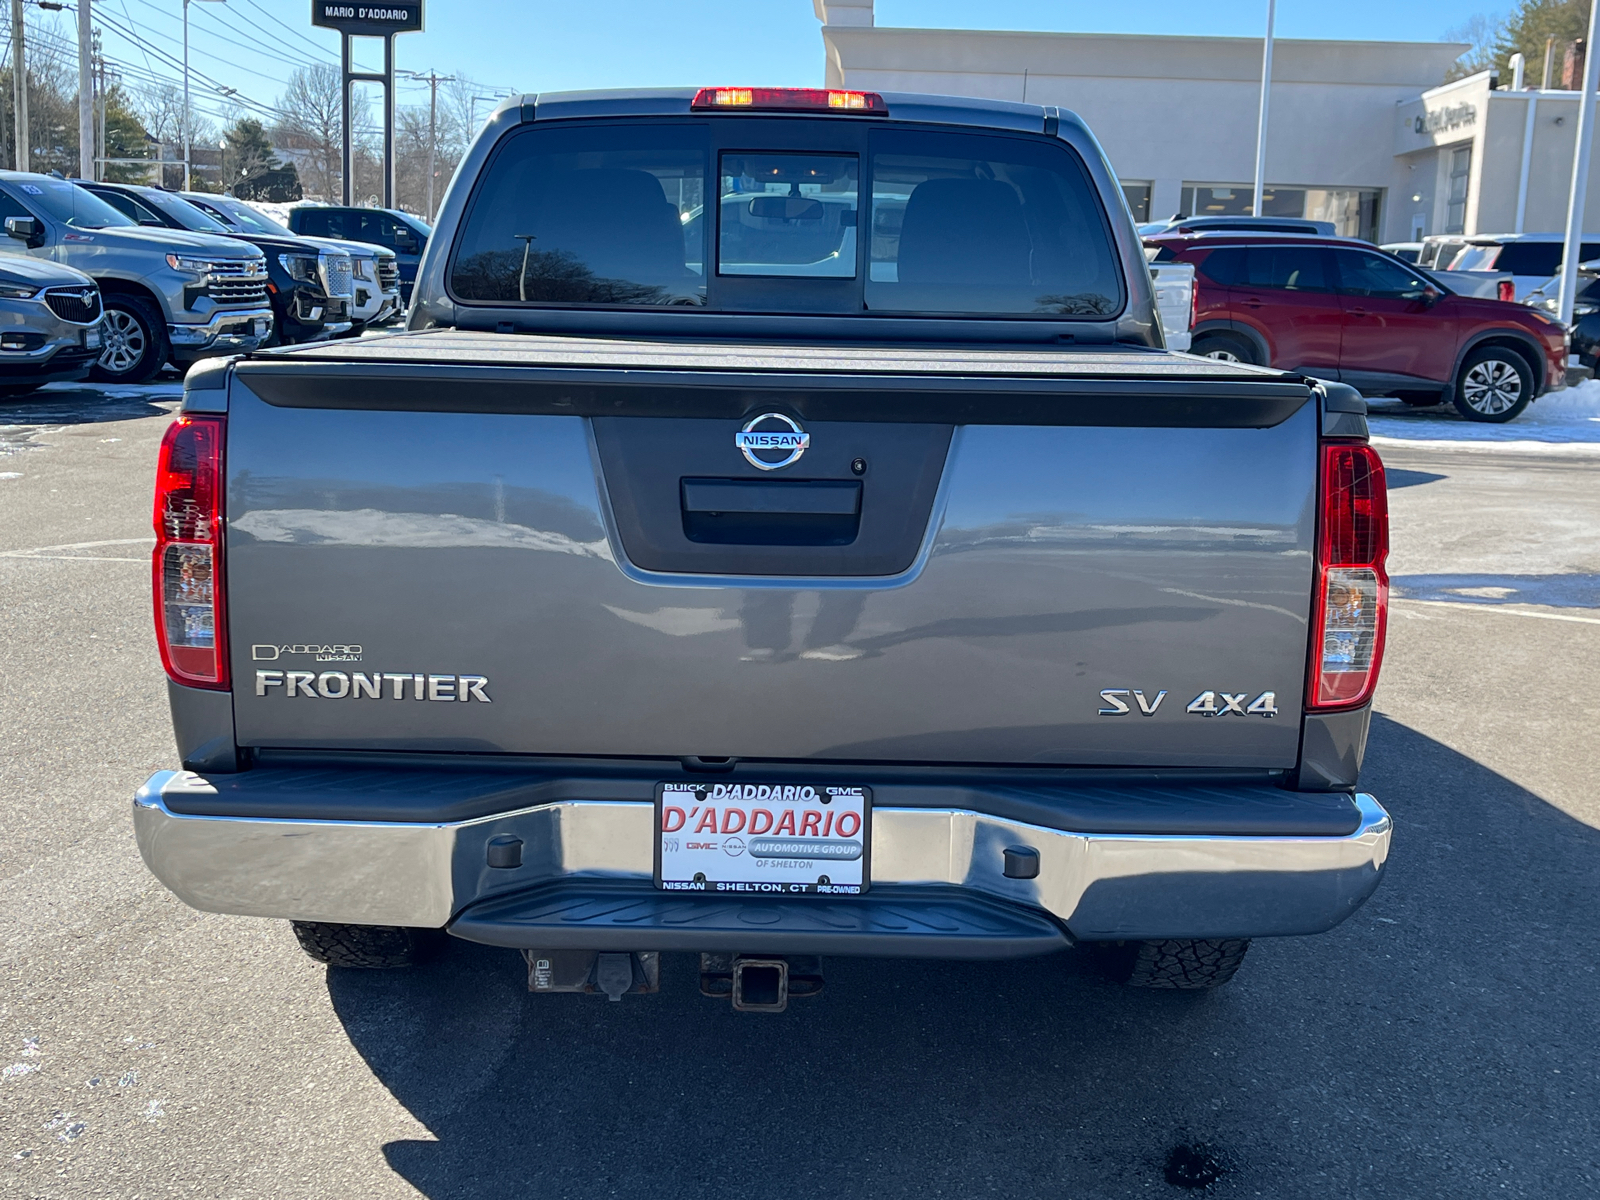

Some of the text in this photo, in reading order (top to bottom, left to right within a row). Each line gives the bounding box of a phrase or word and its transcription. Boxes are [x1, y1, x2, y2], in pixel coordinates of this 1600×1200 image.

[325, 6, 408, 20] MARIO D'ADDARIO
[743, 435, 802, 446] NISSAN
[316, 654, 362, 662] NISSAN
[255, 669, 491, 703] FRONTIER
[1098, 688, 1168, 717] SV
[664, 783, 863, 801] BUICK D'ADDARIO GMC
[662, 806, 861, 838] D'ADDARIO
[686, 842, 718, 850] GMC
[754, 842, 857, 855] AUTOMOTIVE GROUP
[756, 860, 813, 869] OF SHELTON
[663, 882, 860, 894] NISSAN SHELTON, CT PRE-OWNED
